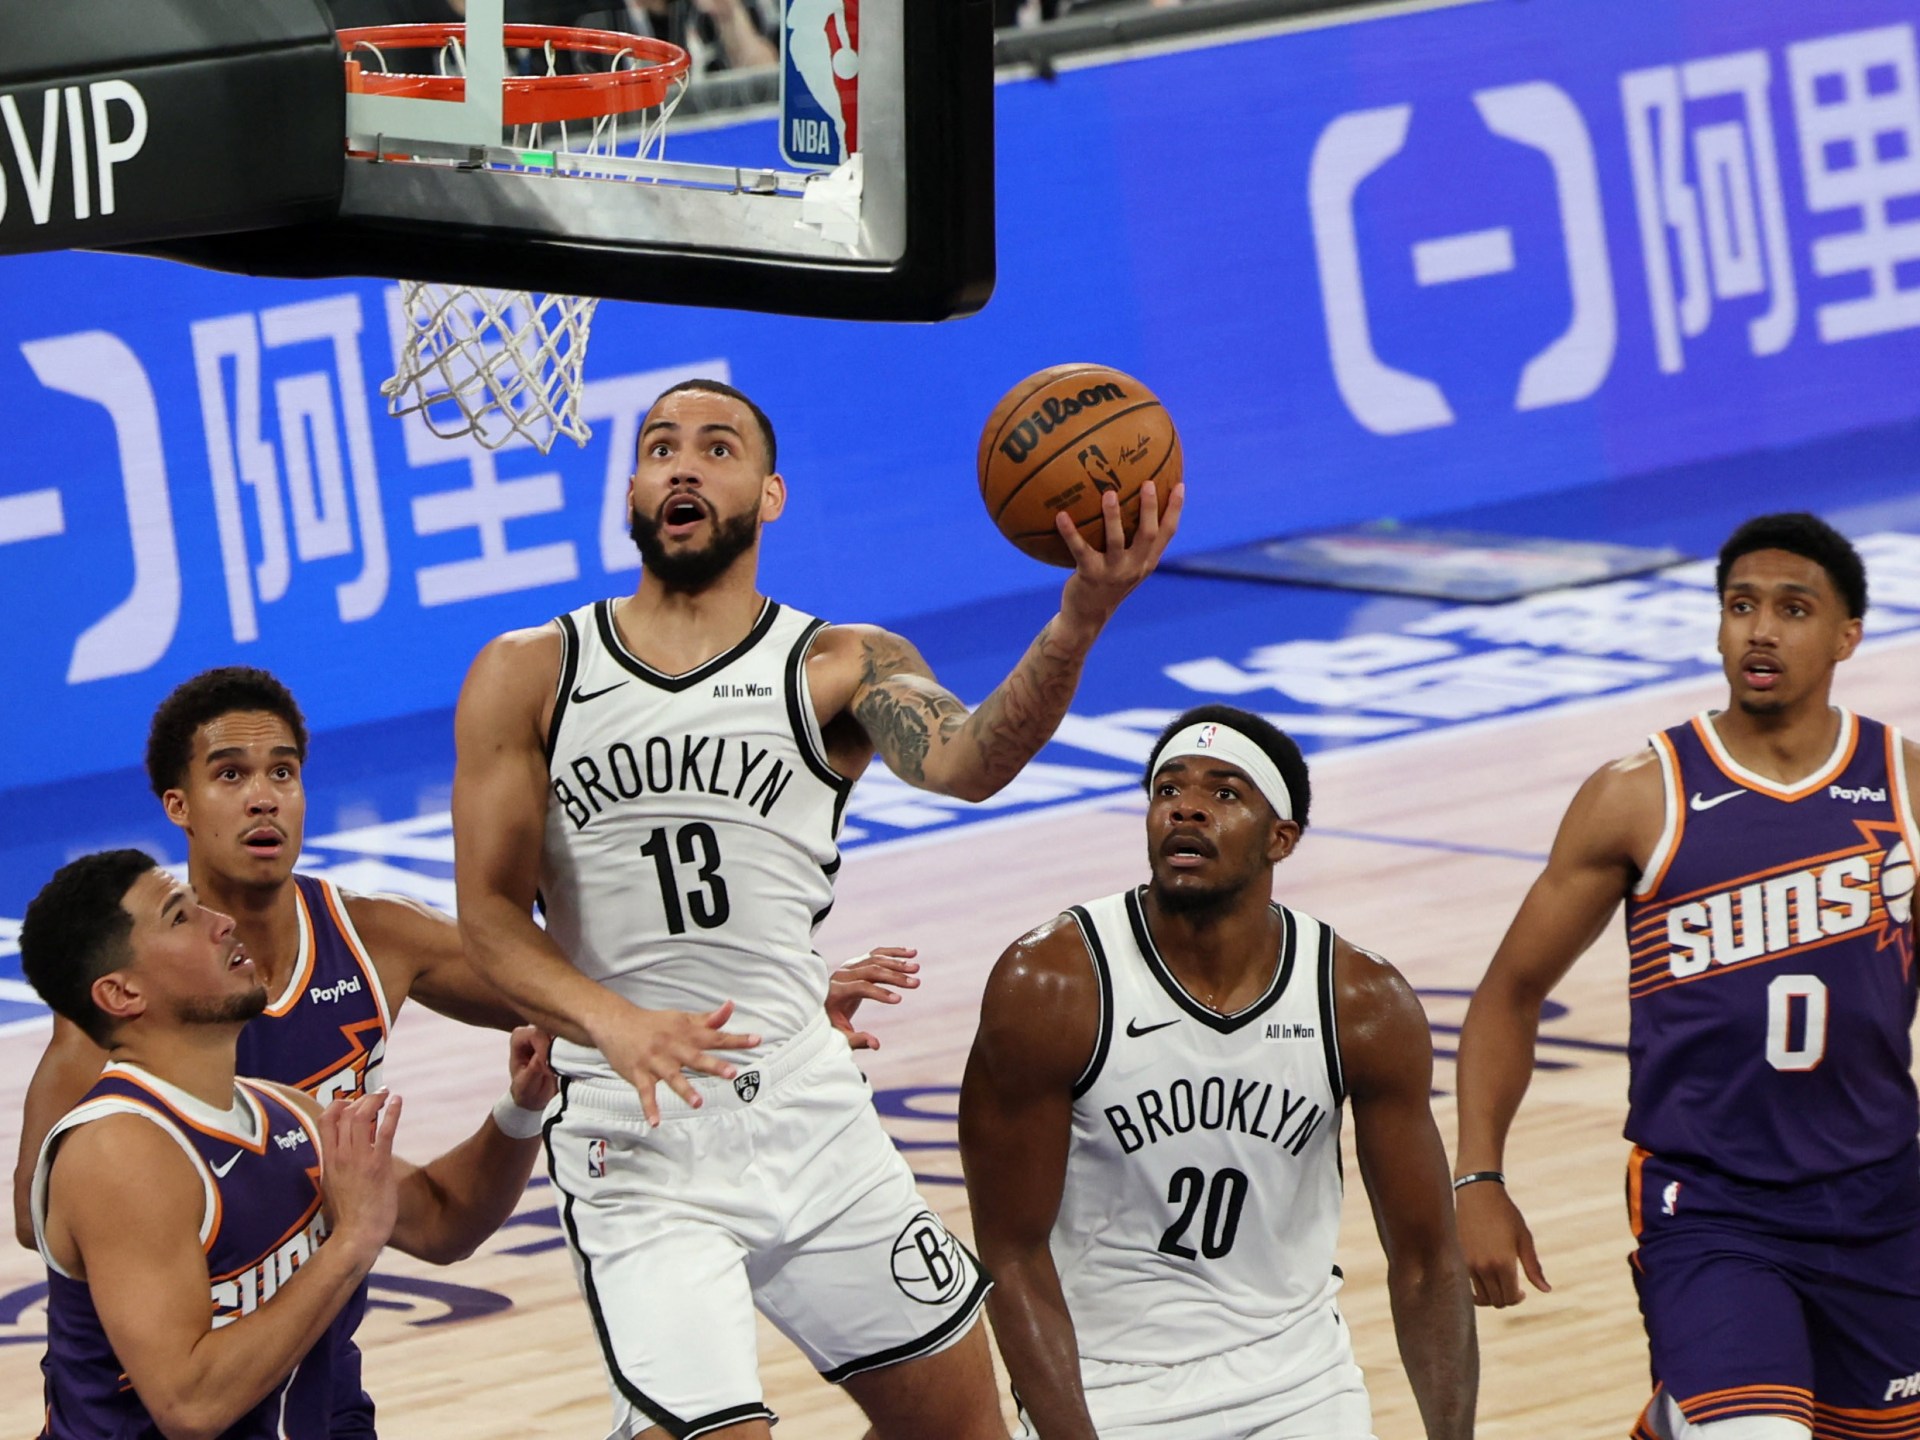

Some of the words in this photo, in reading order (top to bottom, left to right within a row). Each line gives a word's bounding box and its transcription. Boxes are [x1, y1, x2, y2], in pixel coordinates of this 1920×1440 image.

[792, 119, 830, 155] NBA
[1620, 22, 1920, 375] 阿里
[999, 382, 1127, 464] Wilson
[713, 684, 729, 698] All
[732, 684, 744, 698] In
[745, 683, 772, 697] Won
[553, 734, 794, 831] BROOKLYN
[1829, 785, 1887, 804] PayPal
[640, 821, 731, 936] 13
[310, 975, 361, 1004] PayPal
[1265, 1024, 1280, 1039] All
[1282, 1024, 1292, 1039] In
[1293, 1023, 1315, 1039] Won
[1765, 974, 1828, 1072] 0
[735, 1072, 759, 1092] NETS
[273, 1125, 309, 1152] PayPal
[1104, 1076, 1327, 1158] BROOKLYN
[1158, 1166, 1249, 1261] 20
[915, 1226, 953, 1292] B
[1883, 1371, 1920, 1402] PH
